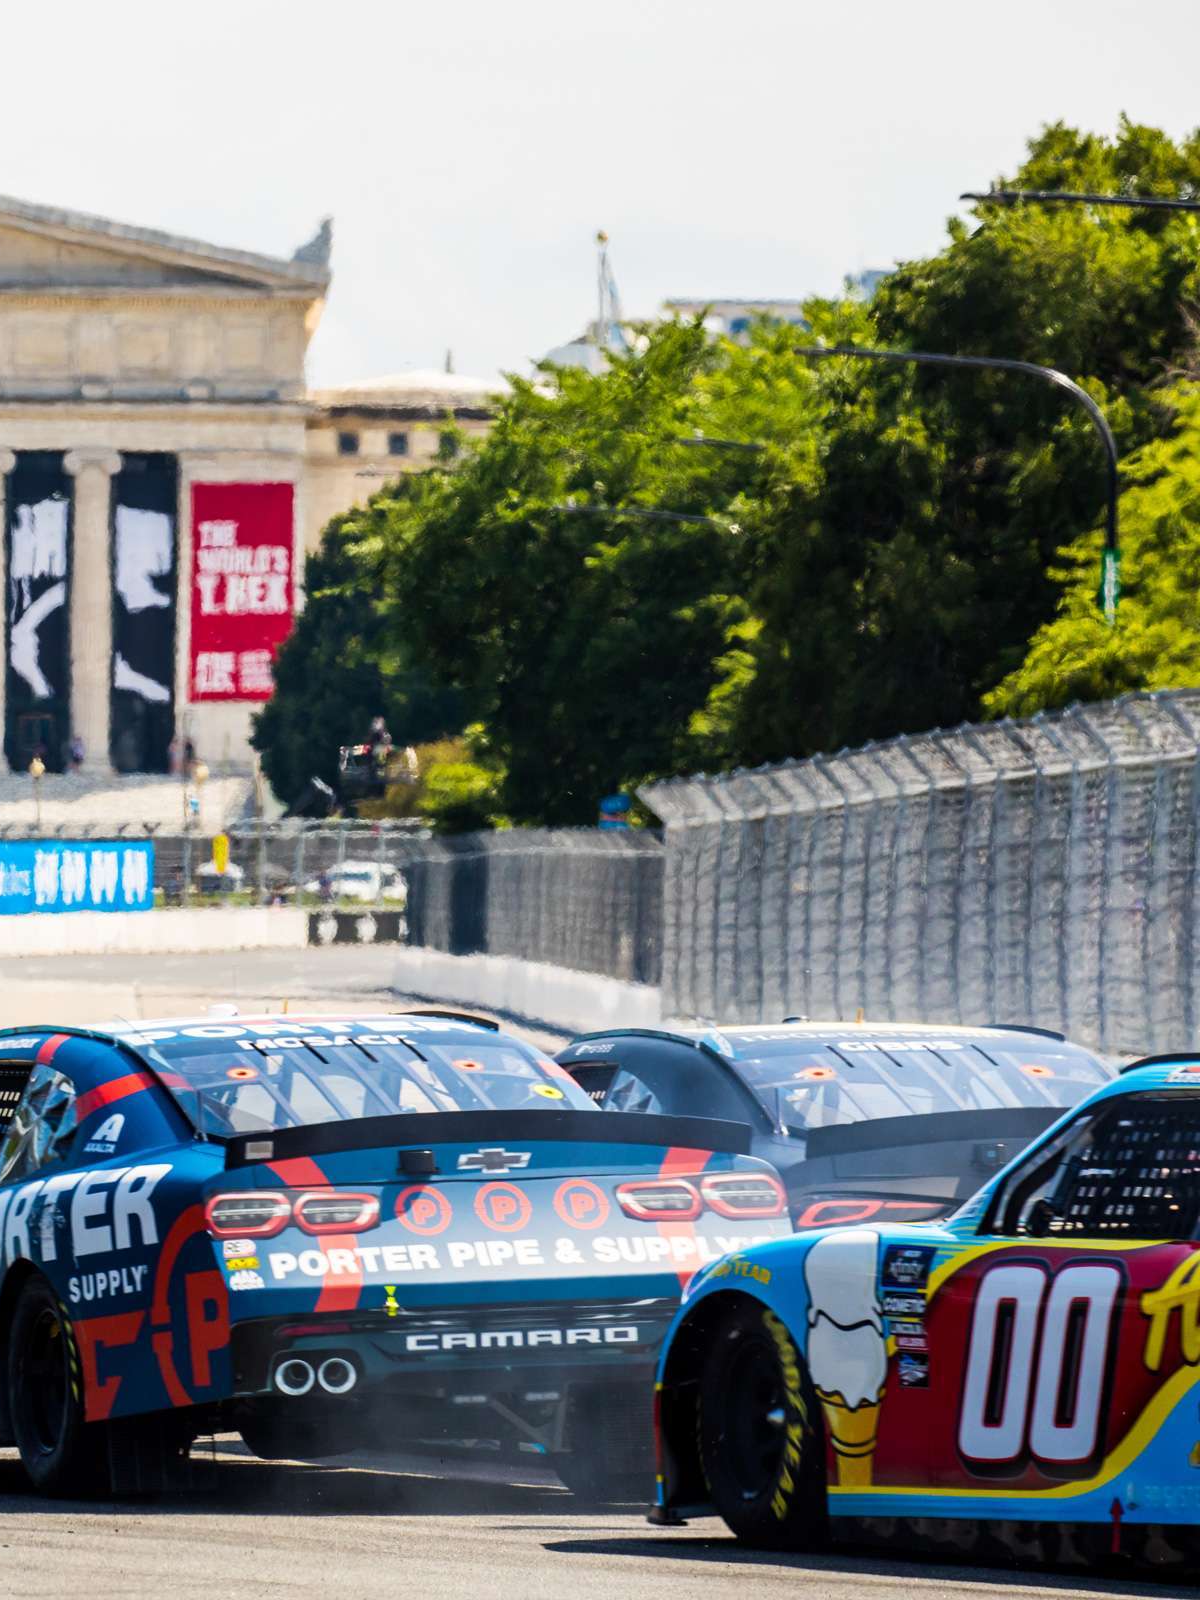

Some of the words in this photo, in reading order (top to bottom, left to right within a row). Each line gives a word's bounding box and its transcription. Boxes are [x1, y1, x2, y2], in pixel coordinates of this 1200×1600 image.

[112, 1020, 492, 1047] PORTER
[236, 1034, 418, 1050] MOSACK
[268, 1243, 441, 1279] PORTER
[447, 1239, 544, 1269] PIPE
[554, 1237, 585, 1264] &
[68, 1264, 147, 1303] SUPPLY
[406, 1326, 639, 1351] CAMARO
[959, 1266, 1121, 1460] 00
